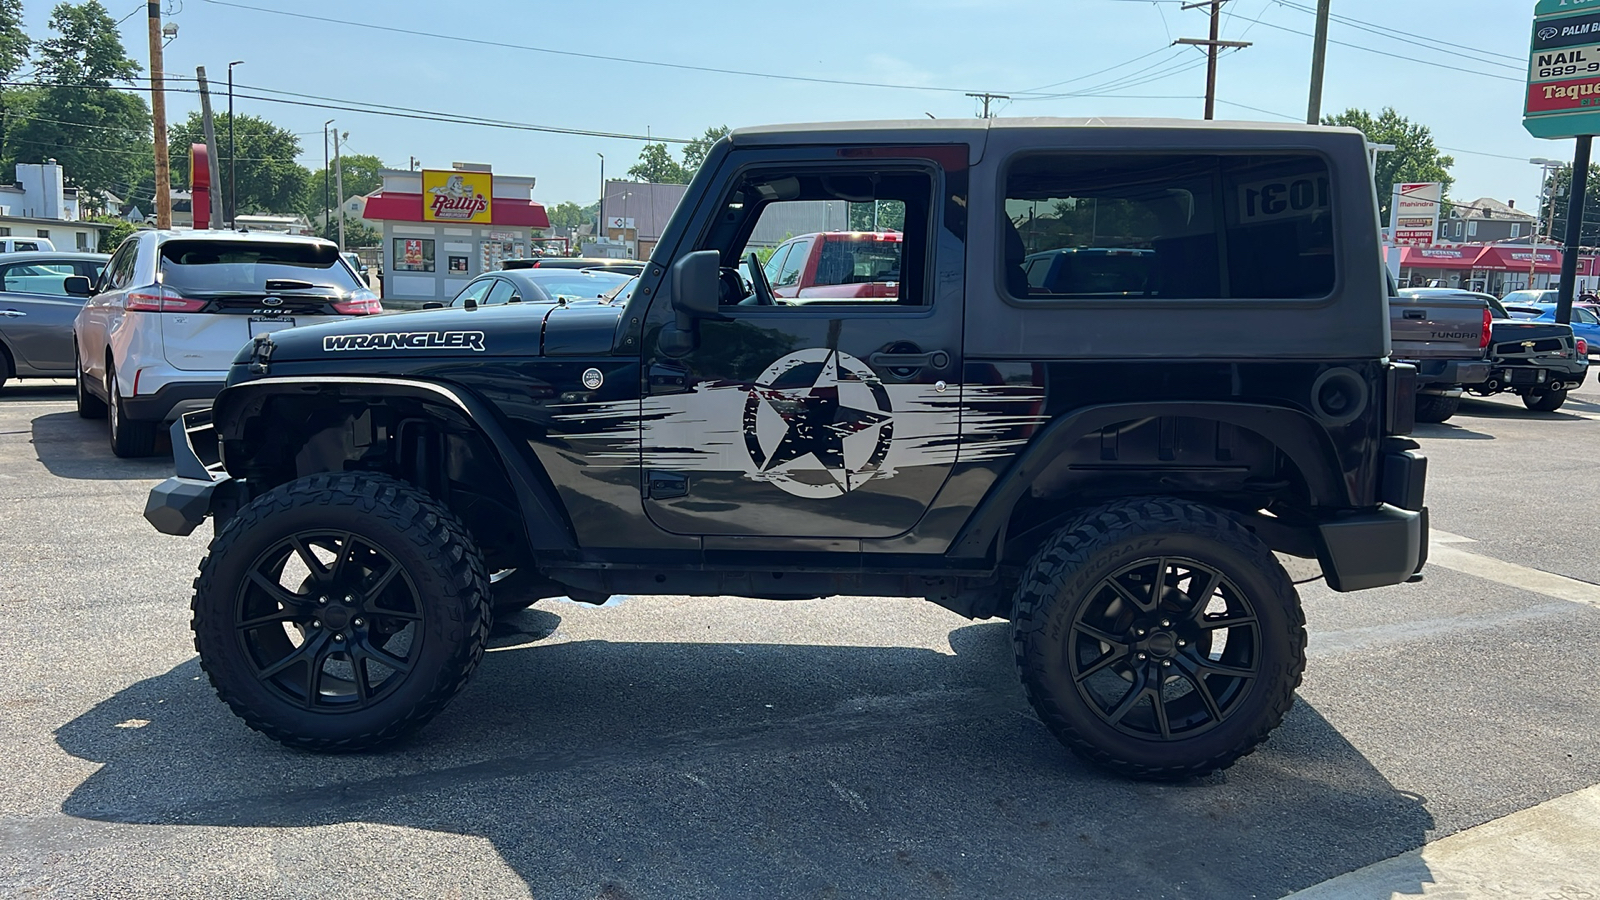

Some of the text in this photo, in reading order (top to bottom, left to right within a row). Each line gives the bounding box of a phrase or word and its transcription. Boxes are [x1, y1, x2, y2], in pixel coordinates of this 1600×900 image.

[1561, 22, 1600, 37] PALM B
[1538, 51, 1587, 67] NAIL
[430, 193, 488, 219] Rally's
[323, 330, 486, 351] WRANGLER
[1430, 331, 1478, 339] TUNDRA
[1051, 537, 1167, 642] MASTERCRAFT
